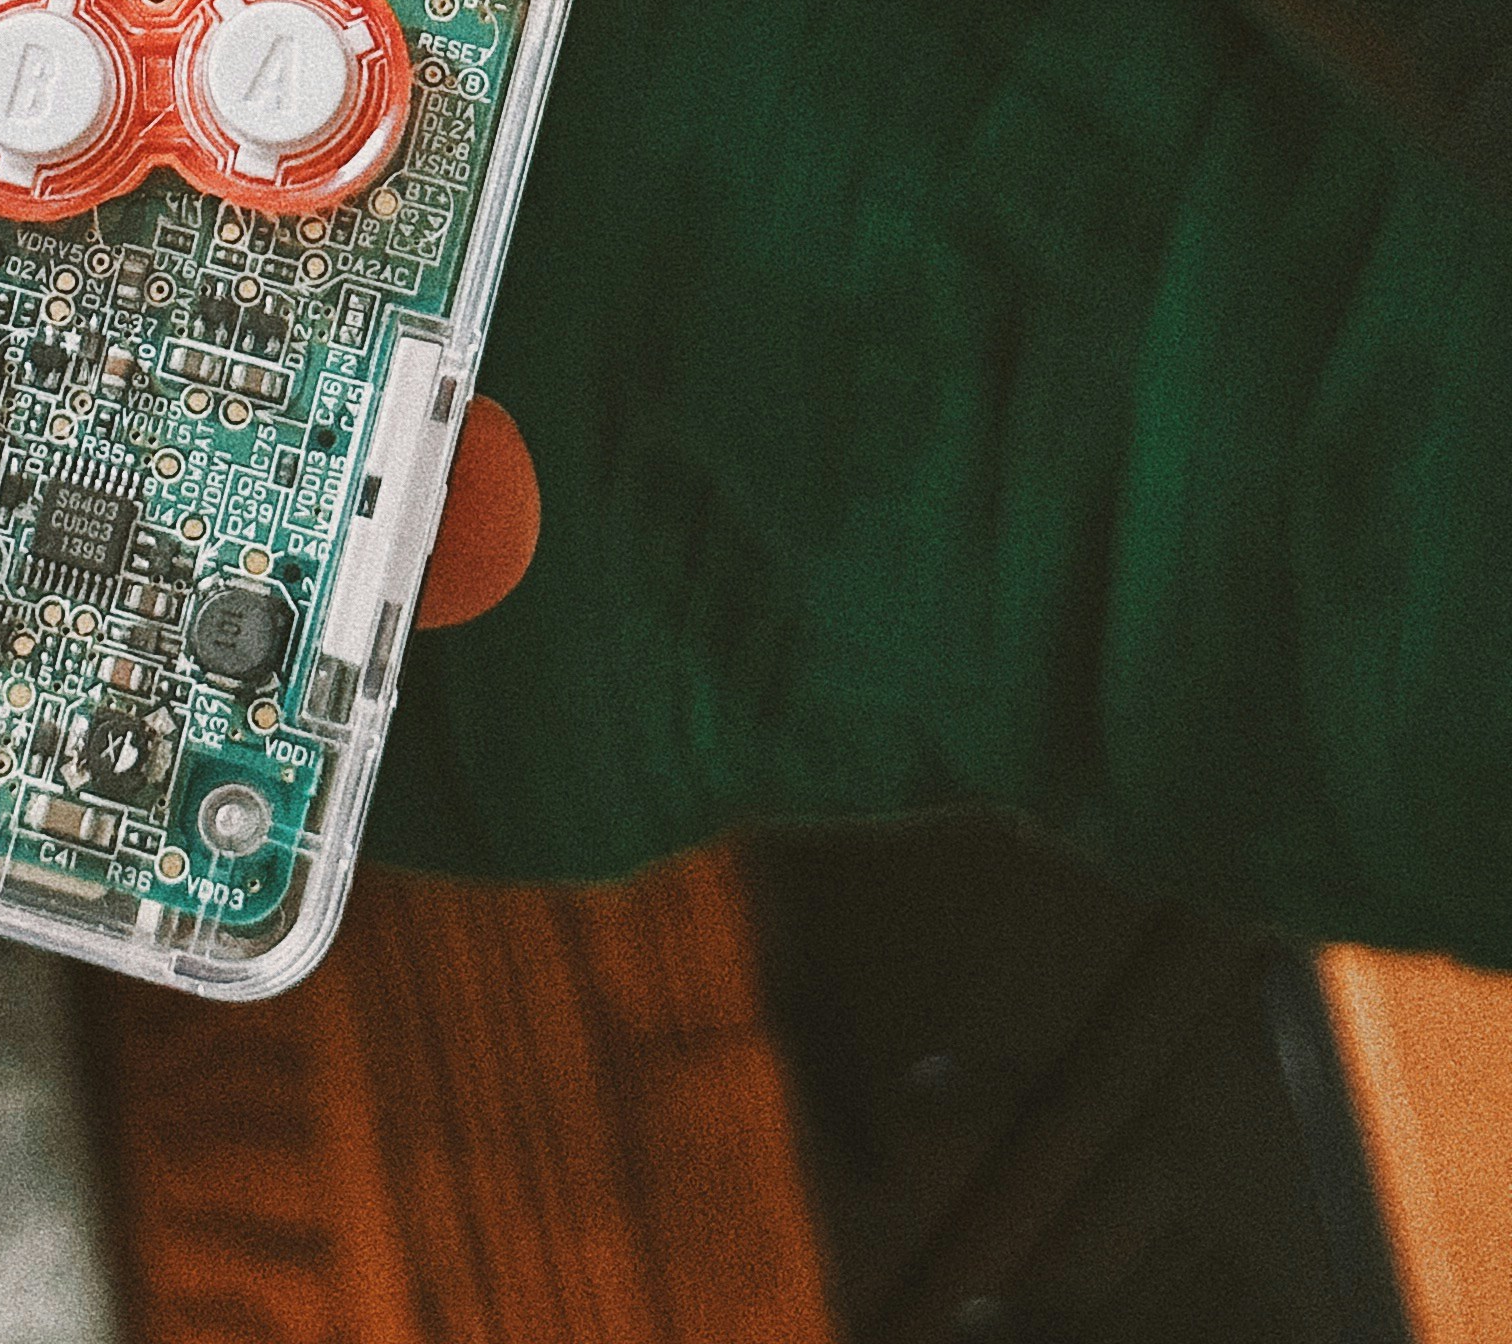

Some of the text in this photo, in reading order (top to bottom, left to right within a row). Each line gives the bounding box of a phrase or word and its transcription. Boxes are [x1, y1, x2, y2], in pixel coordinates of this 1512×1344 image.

[417, 31, 492, 65] RESET
[4, 42, 57, 122] B
[241, 32, 300, 112] A
[16, 229, 86, 263] VDRV5
[337, 251, 411, 287] DA2AC
[128, 388, 184, 421] VDD5
[315, 378, 343, 426] C46
[339, 384, 365, 433] C45
[122, 407, 193, 444] VOUT5
[81, 434, 126, 464] R35
[177, 419, 216, 512] LOWBAT
[56, 487, 120, 521] S6403
[145, 502, 177, 527] U4
[227, 495, 274, 524] C39
[225, 515, 258, 540] D4
[208, 698, 234, 750] R37
[263, 736, 317, 769] VDD1
[38, 841, 79, 870] C41
[105, 861, 154, 893] R36
[187, 874, 245, 911] VDD3
